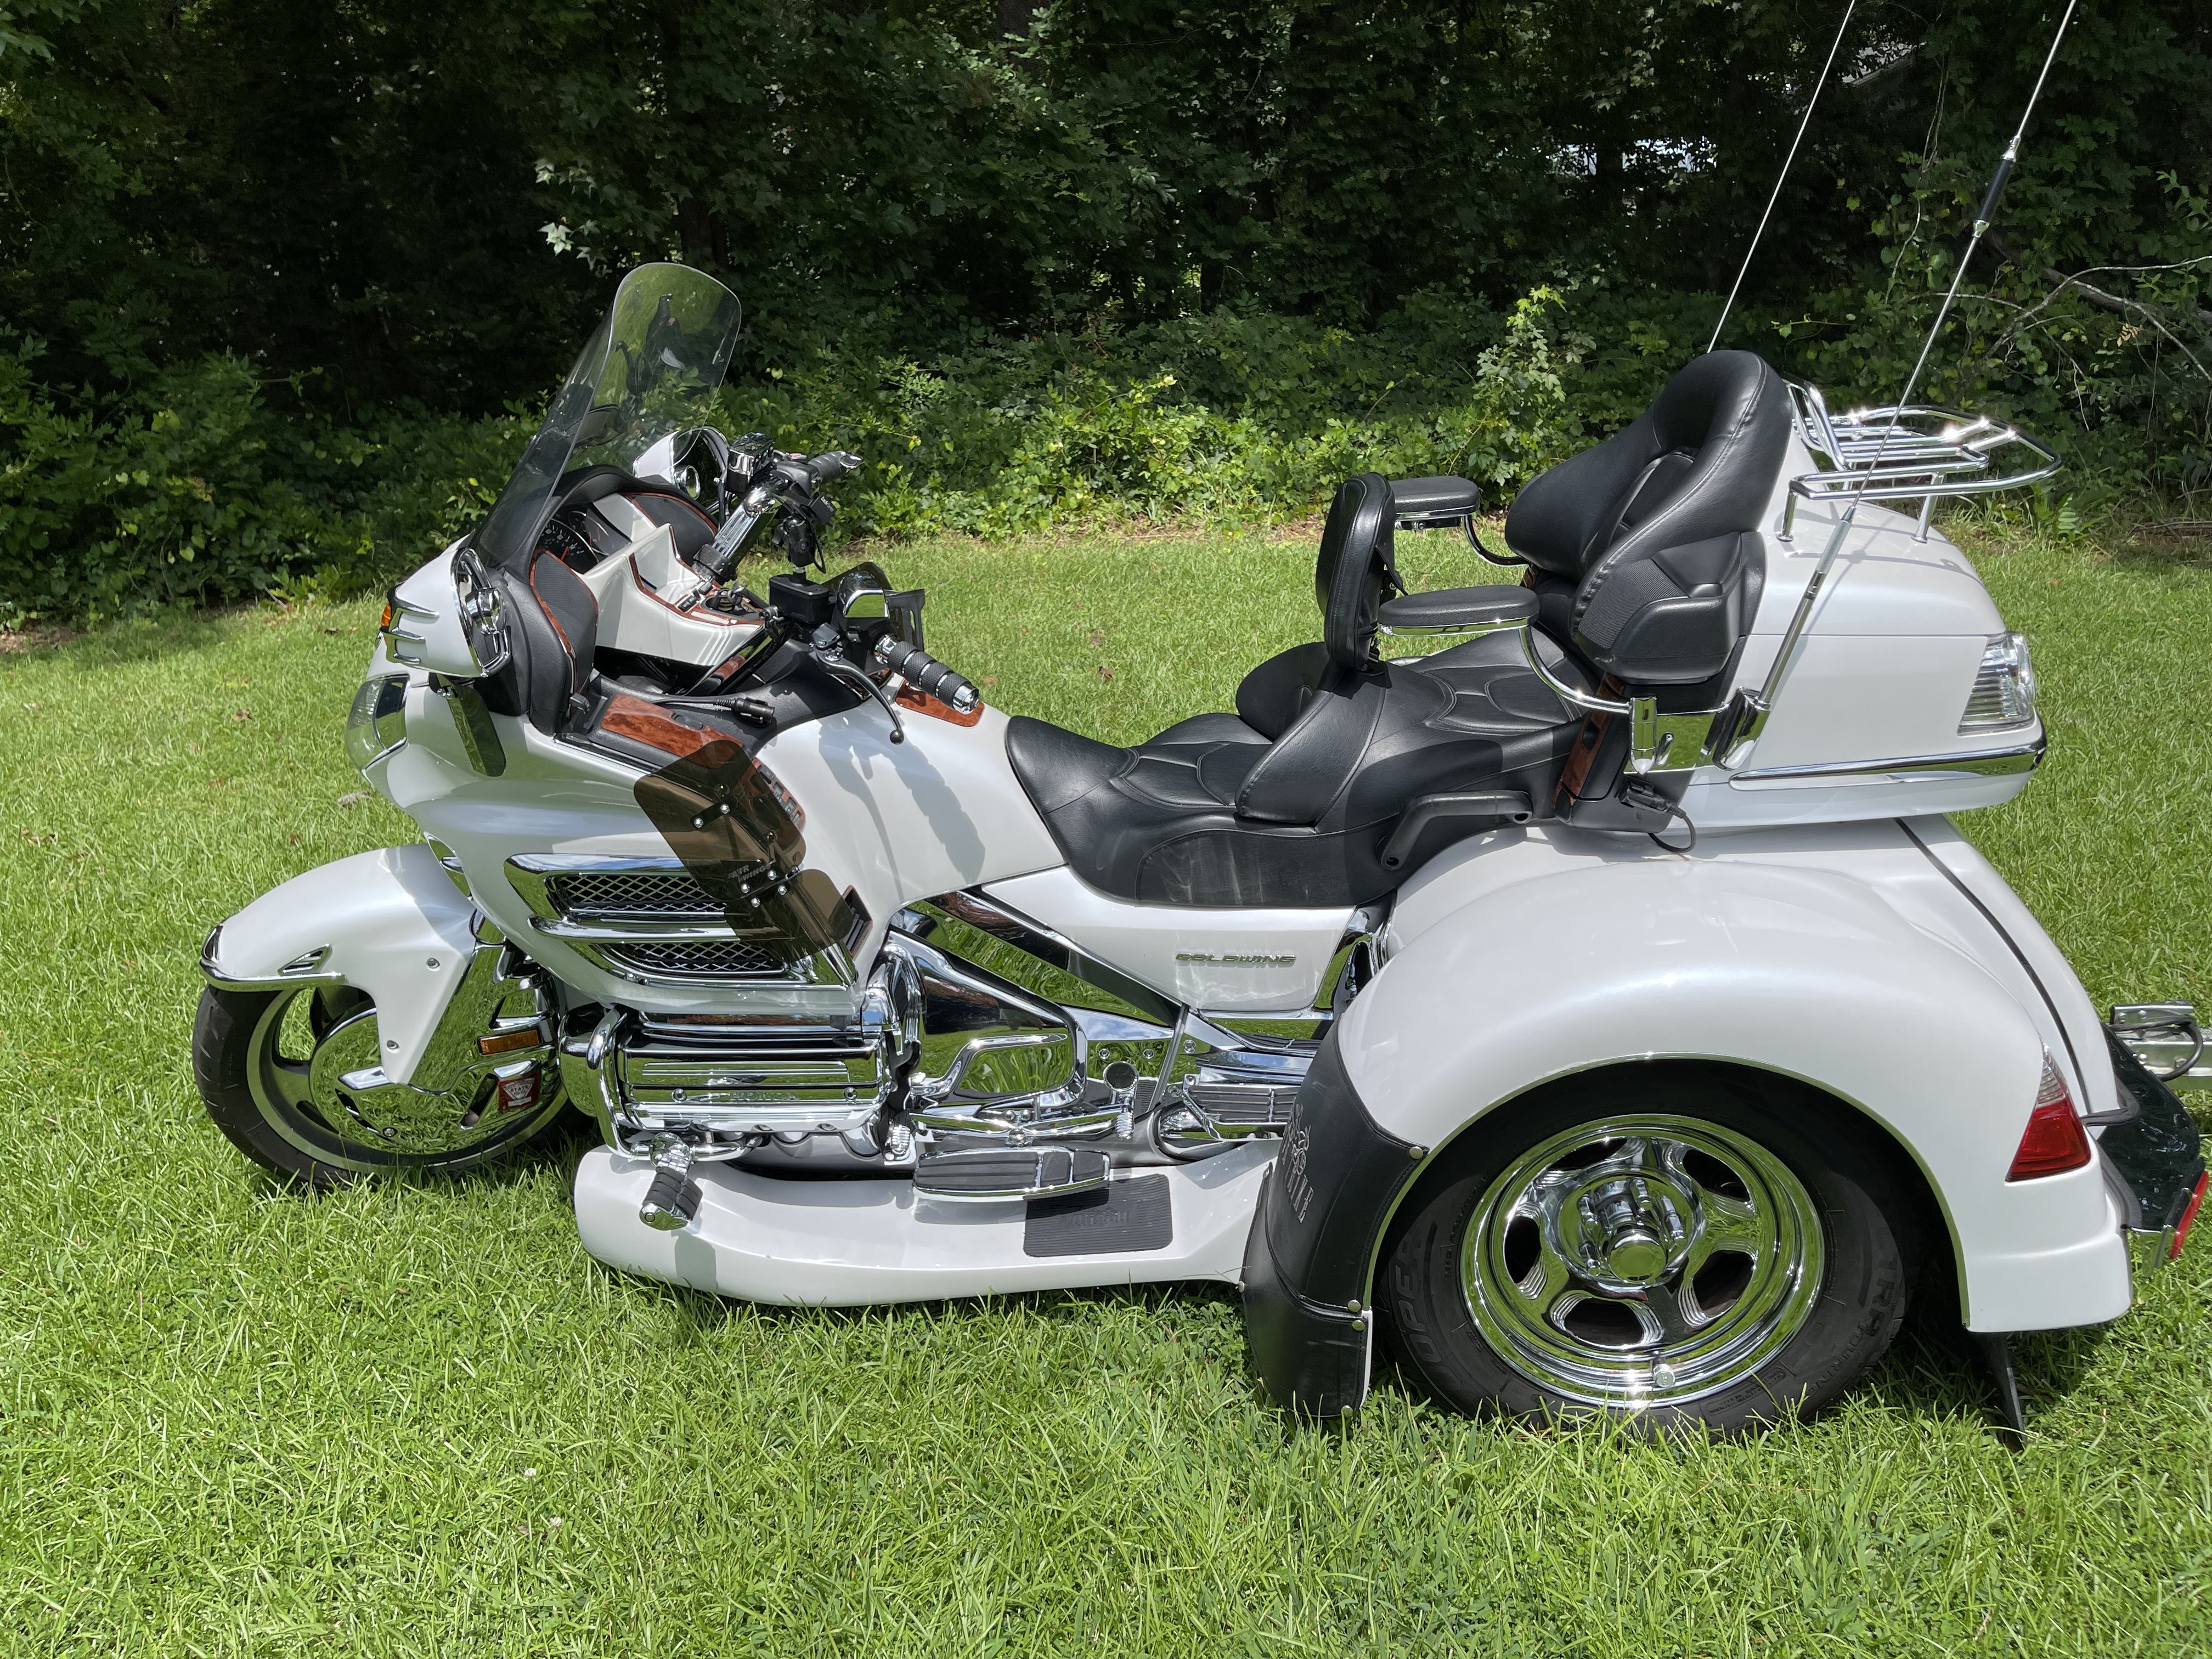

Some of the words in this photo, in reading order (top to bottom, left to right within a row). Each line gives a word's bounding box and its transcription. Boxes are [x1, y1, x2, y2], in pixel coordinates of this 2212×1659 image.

[732, 865, 749, 878] AIR
[742, 864, 771, 881] WINGS
[1175, 952, 1297, 964] GOLDWING
[729, 1091, 802, 1102] HONDA
